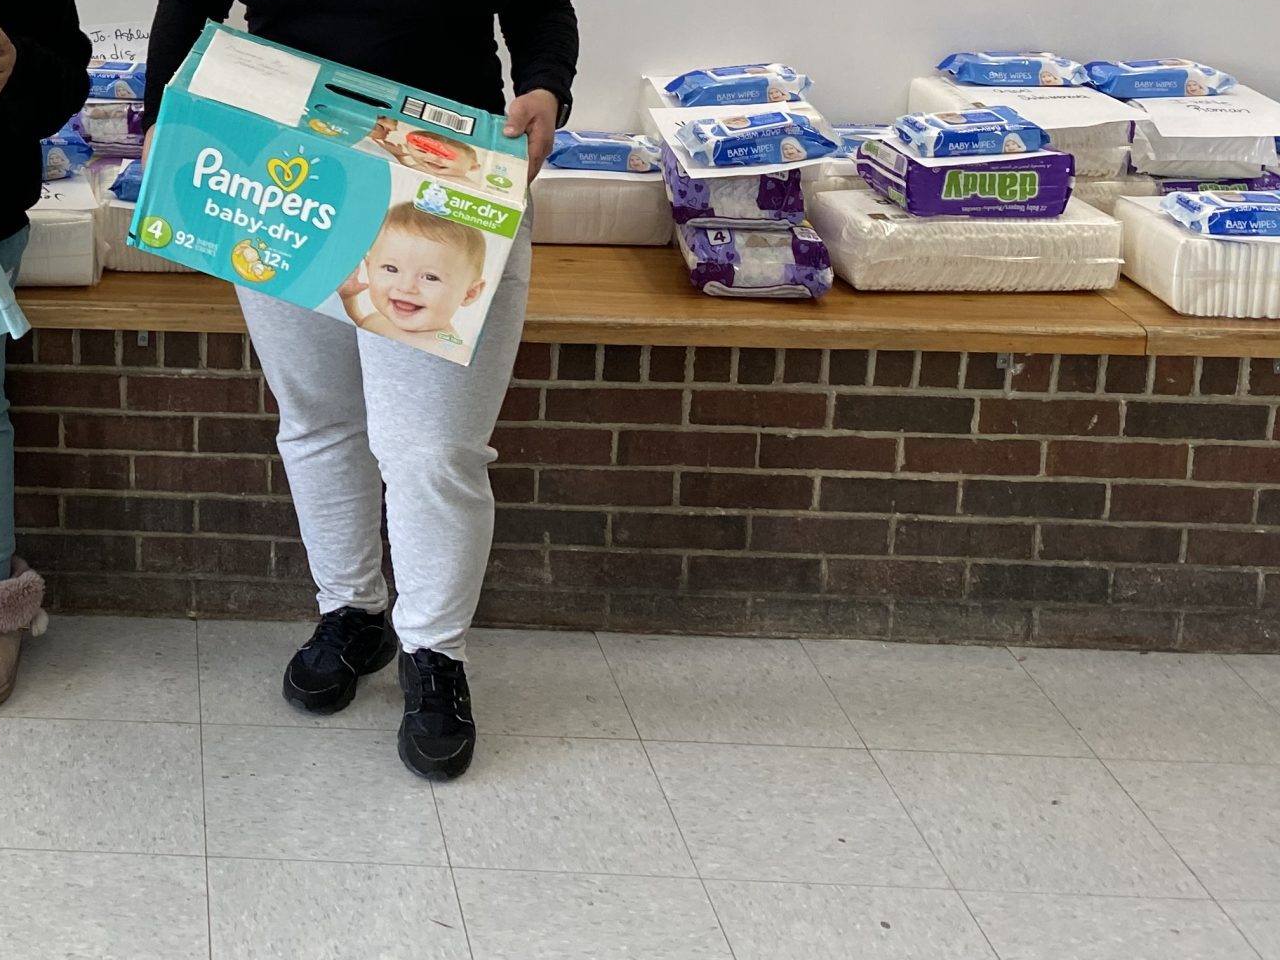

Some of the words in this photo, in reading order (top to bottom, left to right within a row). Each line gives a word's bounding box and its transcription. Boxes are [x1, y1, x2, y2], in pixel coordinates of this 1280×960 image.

[989, 71, 1008, 79] BABY
[1010, 71, 1032, 80] WIPES
[1134, 80, 1154, 88] BABY
[1156, 81, 1178, 89] WIPES
[716, 93, 735, 102] BABY
[738, 90, 760, 99] WIPES
[727, 147, 750, 158] BABY
[751, 143, 774, 155] WIPES
[949, 142, 970, 151] BABY
[971, 140, 996, 149] WIPES
[579, 152, 598, 160] BABY
[600, 153, 622, 161] WIPES
[192, 147, 336, 230] Pampers
[941, 169, 1039, 201] dandy
[449, 196, 509, 224] air-dry
[146, 220, 163, 239] 4
[204, 198, 308, 249] baby-dry
[1225, 220, 1247, 229] BABY
[1249, 220, 1277, 229] WIPES
[174, 230, 195, 249] 92
[713, 231, 726, 243] 4
